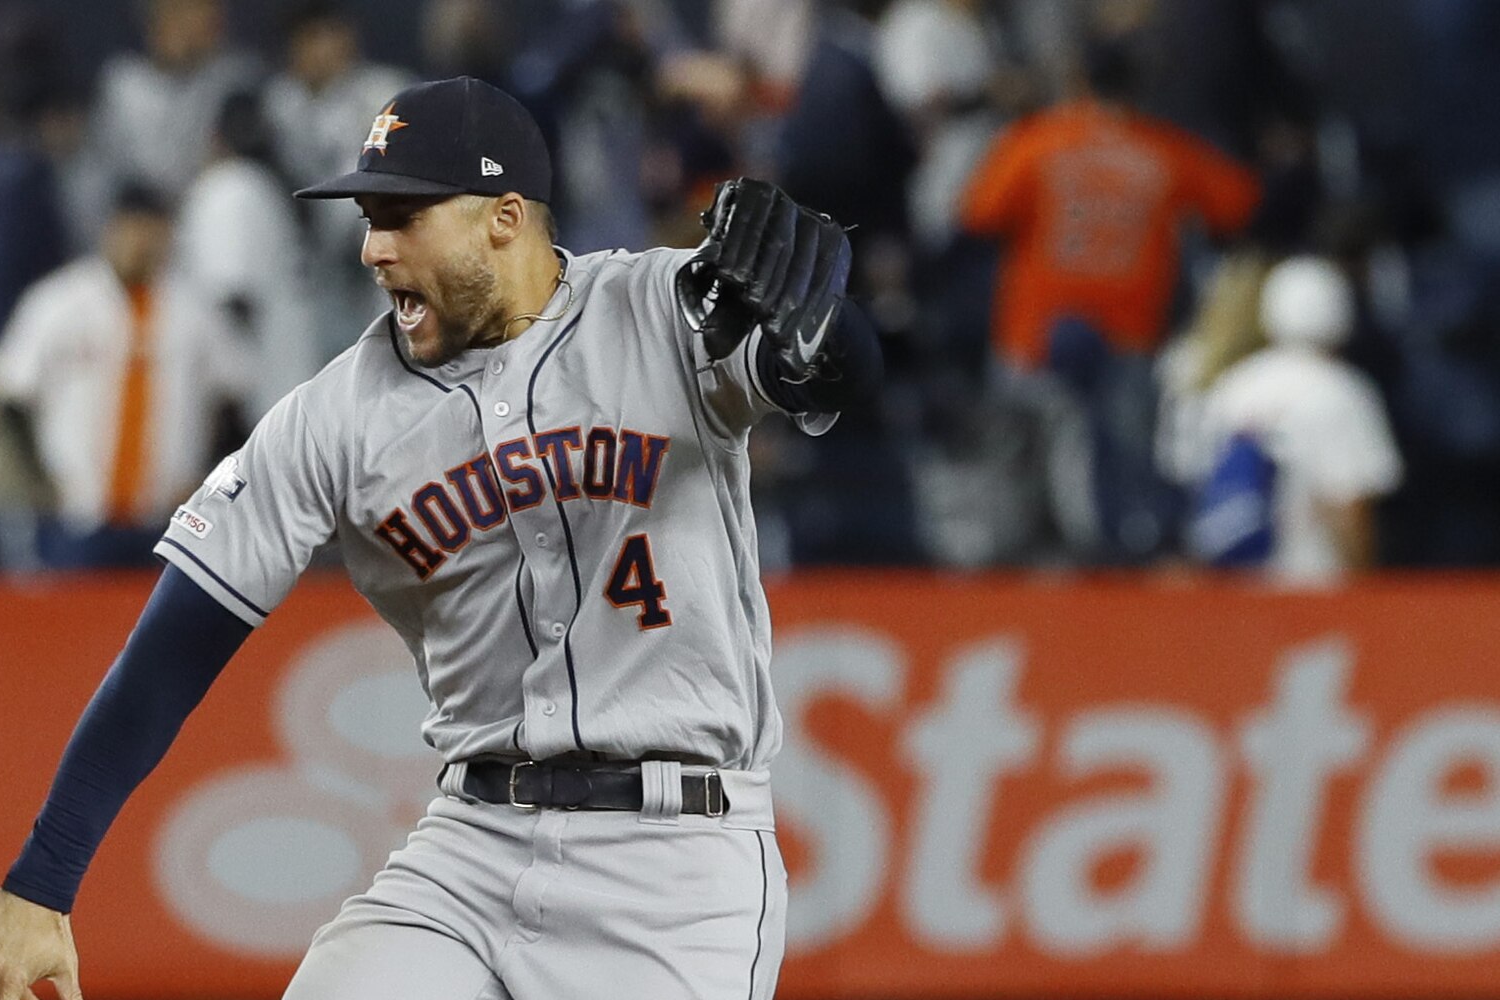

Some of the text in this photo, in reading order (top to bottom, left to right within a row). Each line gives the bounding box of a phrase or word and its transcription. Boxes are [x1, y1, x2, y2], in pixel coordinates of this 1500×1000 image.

[374, 426, 670, 581] HOUSTON
[603, 532, 672, 631] 4
[770, 625, 1500, 956] State
